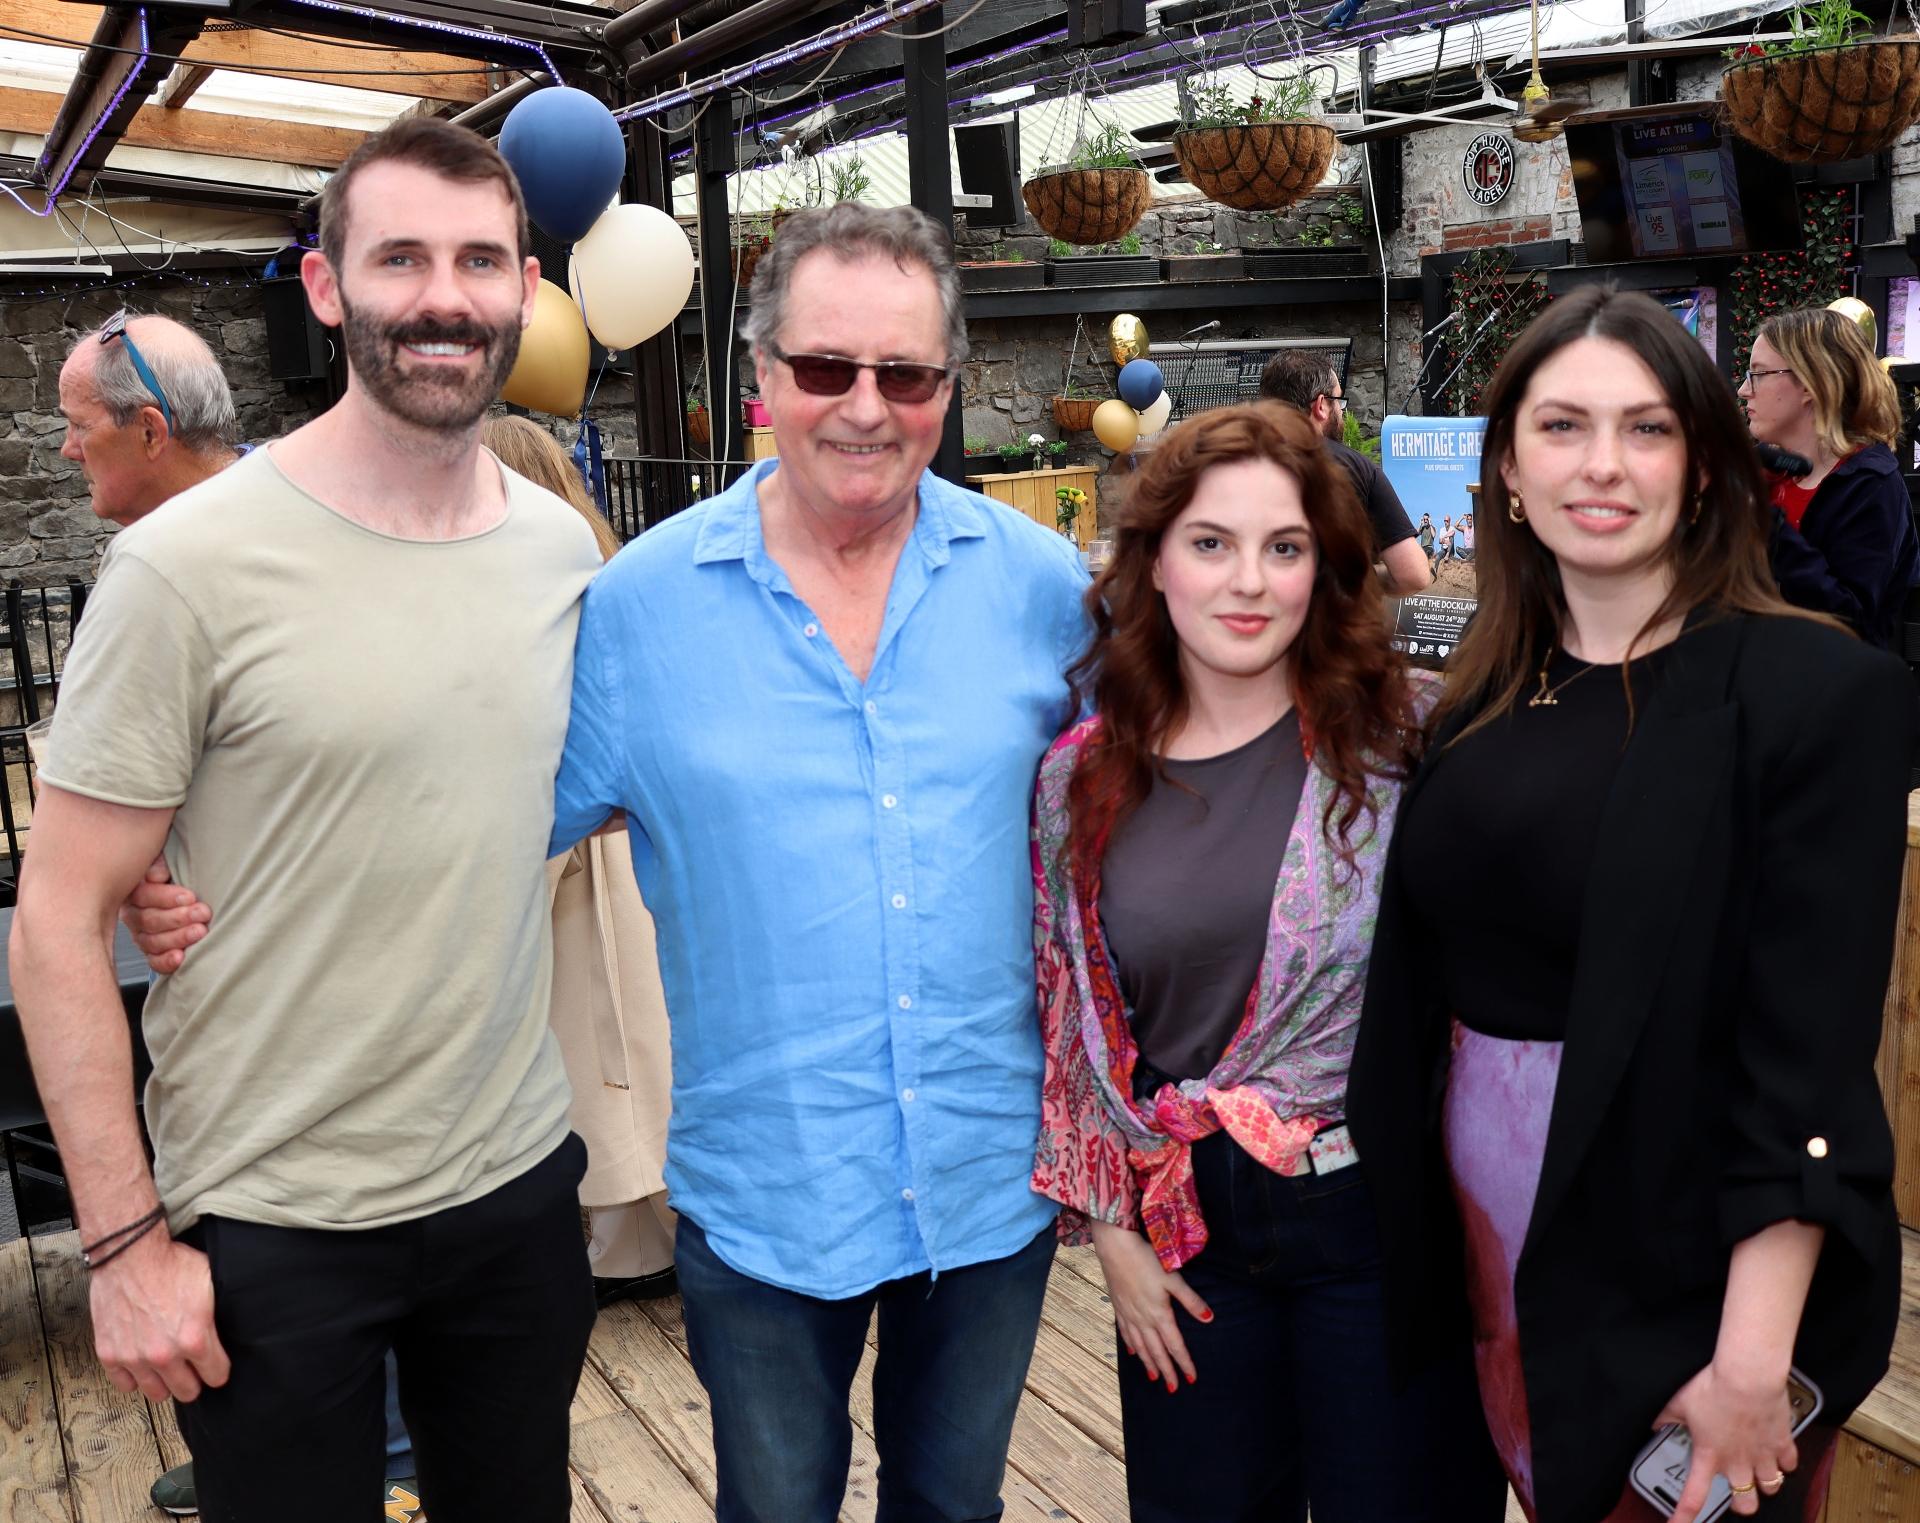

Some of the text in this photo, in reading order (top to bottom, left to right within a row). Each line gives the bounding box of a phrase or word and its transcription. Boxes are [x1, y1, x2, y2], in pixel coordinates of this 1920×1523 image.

[1633, 123, 1695, 140] LIVE AT THE
[1464, 135, 1510, 169] HOP HOUSE
[1656, 144, 1689, 153] SPONSORS
[1471, 184, 1504, 202] LAGER
[1651, 222, 1664, 234] 95
[1391, 431, 1485, 457] HERMITAGE GRE
[1404, 597, 1418, 606] LIVE
[1419, 598, 1428, 607] AT
[1428, 599, 1440, 608] THE
[1423, 613, 1445, 621] AUGUST
